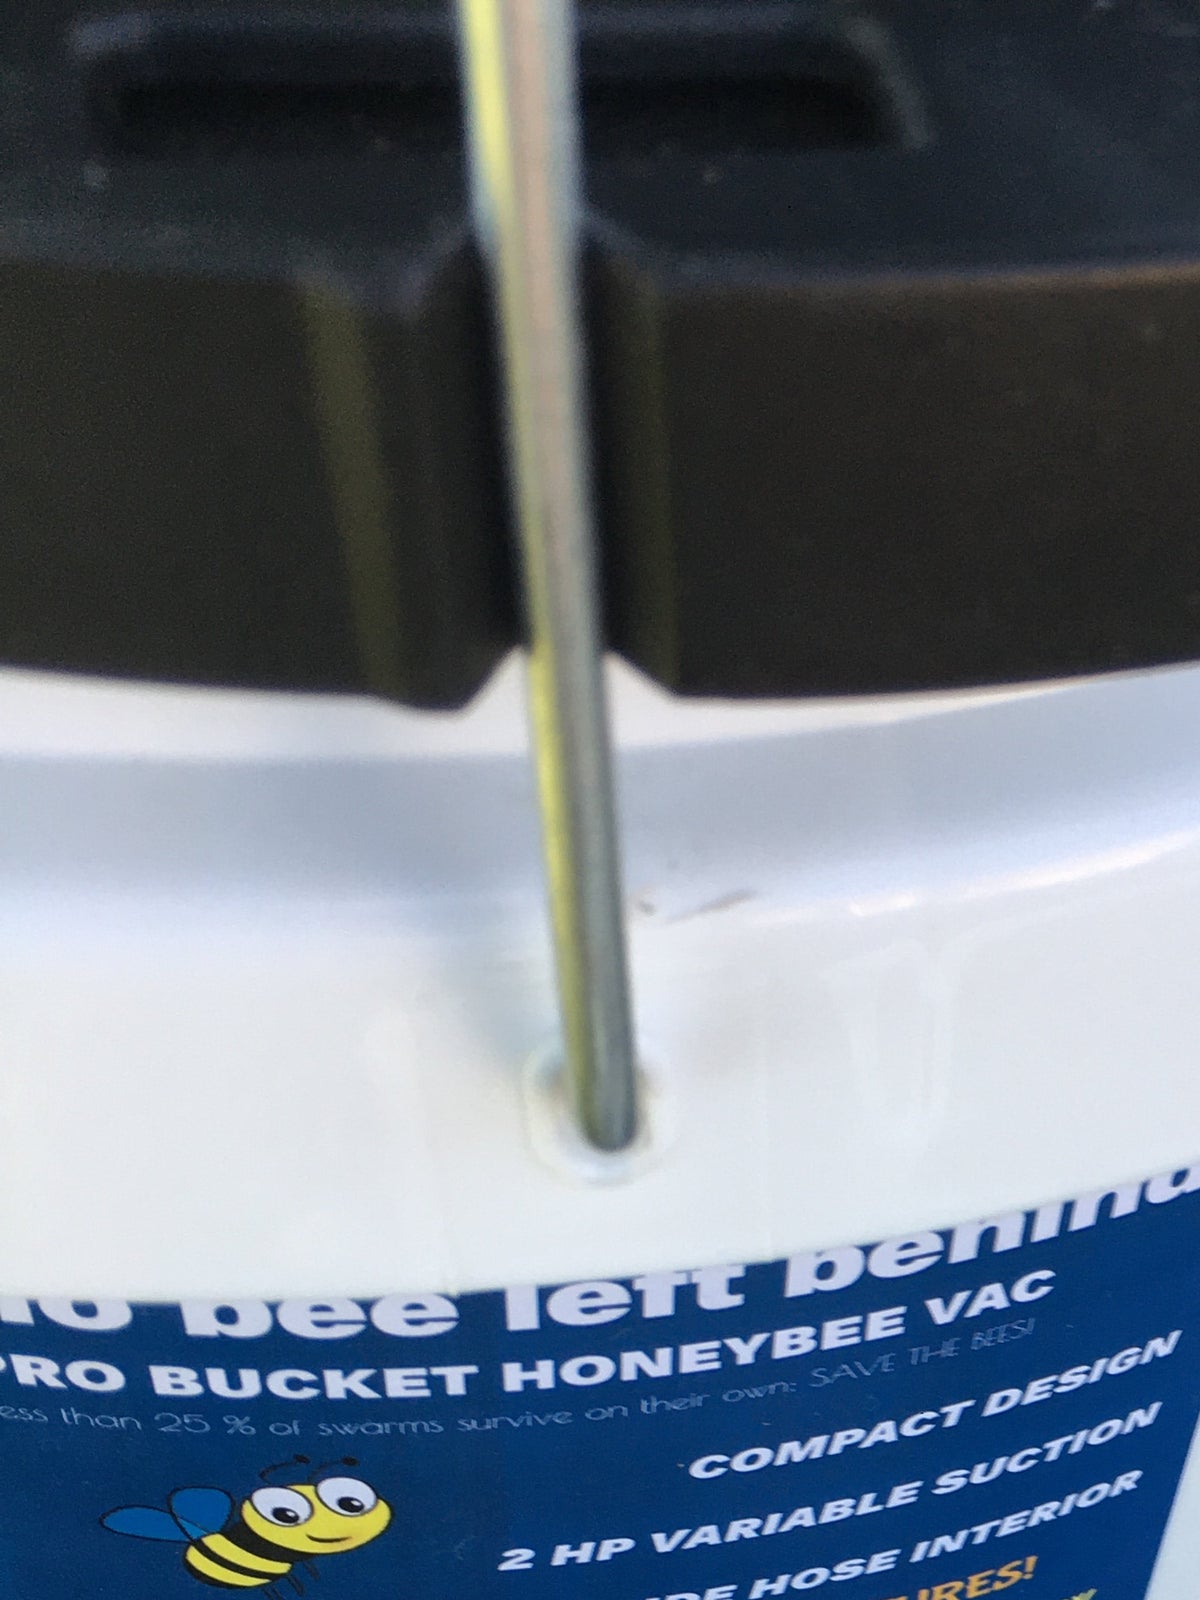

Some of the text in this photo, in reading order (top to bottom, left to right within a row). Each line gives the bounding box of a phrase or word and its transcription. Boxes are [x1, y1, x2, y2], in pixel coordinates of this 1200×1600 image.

[0, 1300, 133, 1331] o
[505, 1264, 746, 1331] left
[0, 1269, 1056, 1400] RO BUCKET HONEYBEE VAC
[0, 1405, 50, 1422] ess
[60, 1407, 142, 1430] than
[154, 1412, 210, 1433] 25
[223, 1415, 256, 1435] %
[269, 1420, 300, 1436] of
[318, 1421, 444, 1435] swarms
[457, 1411, 572, 1431] survive
[585, 1405, 628, 1421] on
[639, 1389, 712, 1415] their
[809, 1351, 899, 1388] SAVE
[910, 1337, 963, 1367] THE
[689, 1330, 1182, 1479] COMPACT DESIGN
[497, 1399, 1163, 1571] 2 HP VARIABLE SUCTION
[749, 1549, 901, 1600] HOSE
[909, 1469, 1143, 1563] INTERIOR
